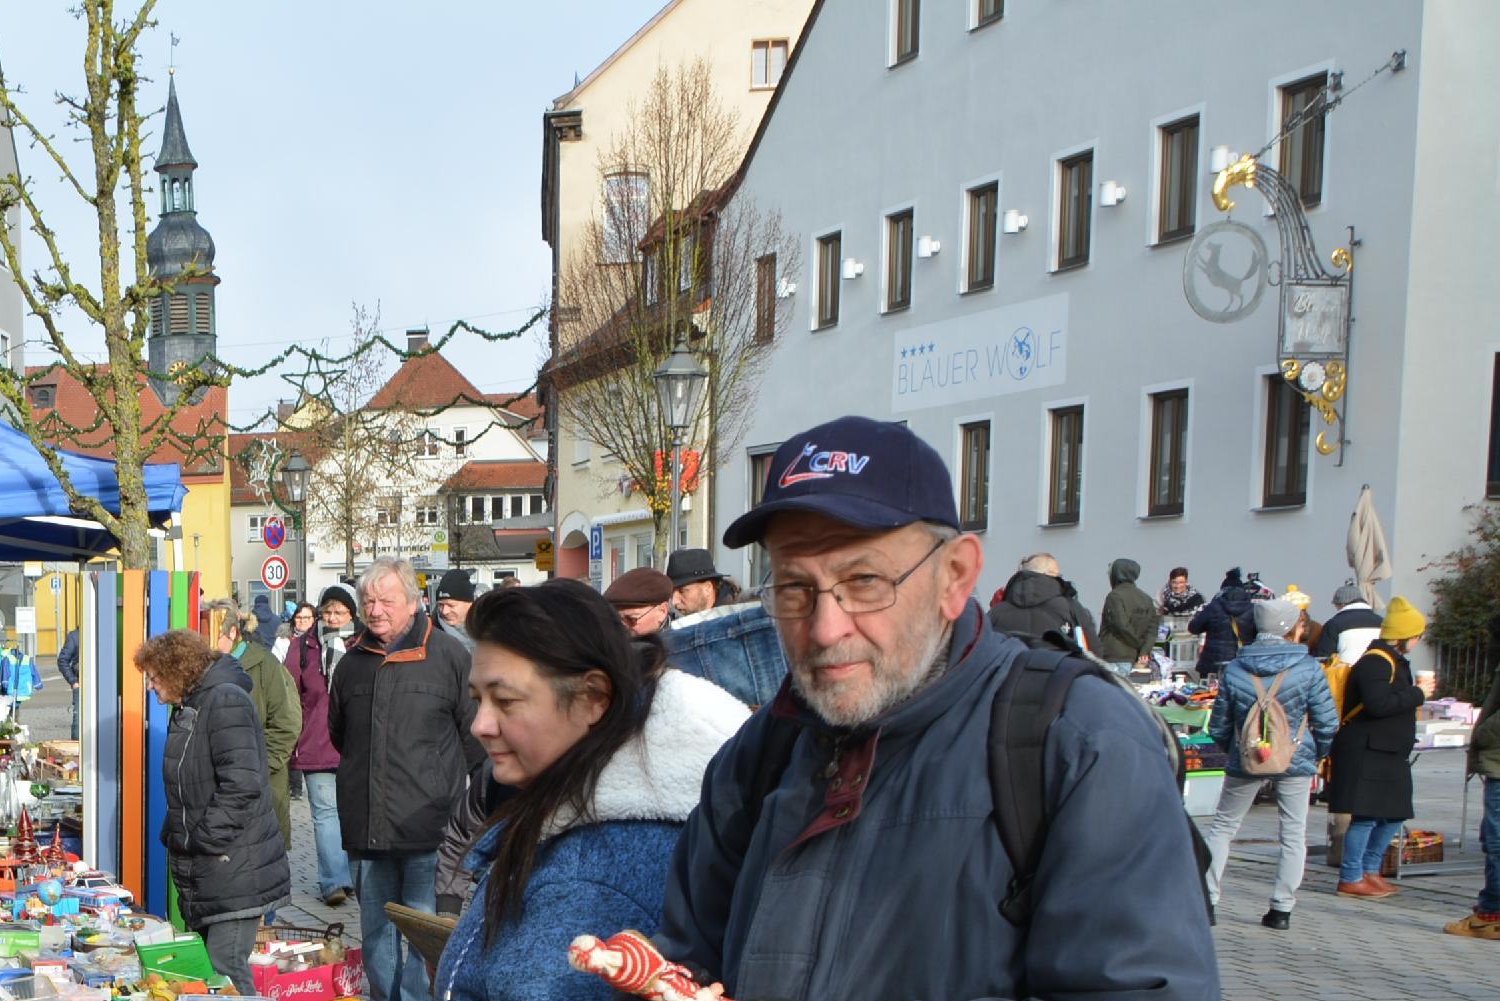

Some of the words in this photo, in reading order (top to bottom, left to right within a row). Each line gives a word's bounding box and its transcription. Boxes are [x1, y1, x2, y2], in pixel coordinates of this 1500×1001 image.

[898, 348, 980, 395] BLAUER
[809, 451, 870, 475] CRV
[267, 565, 283, 580] 30
